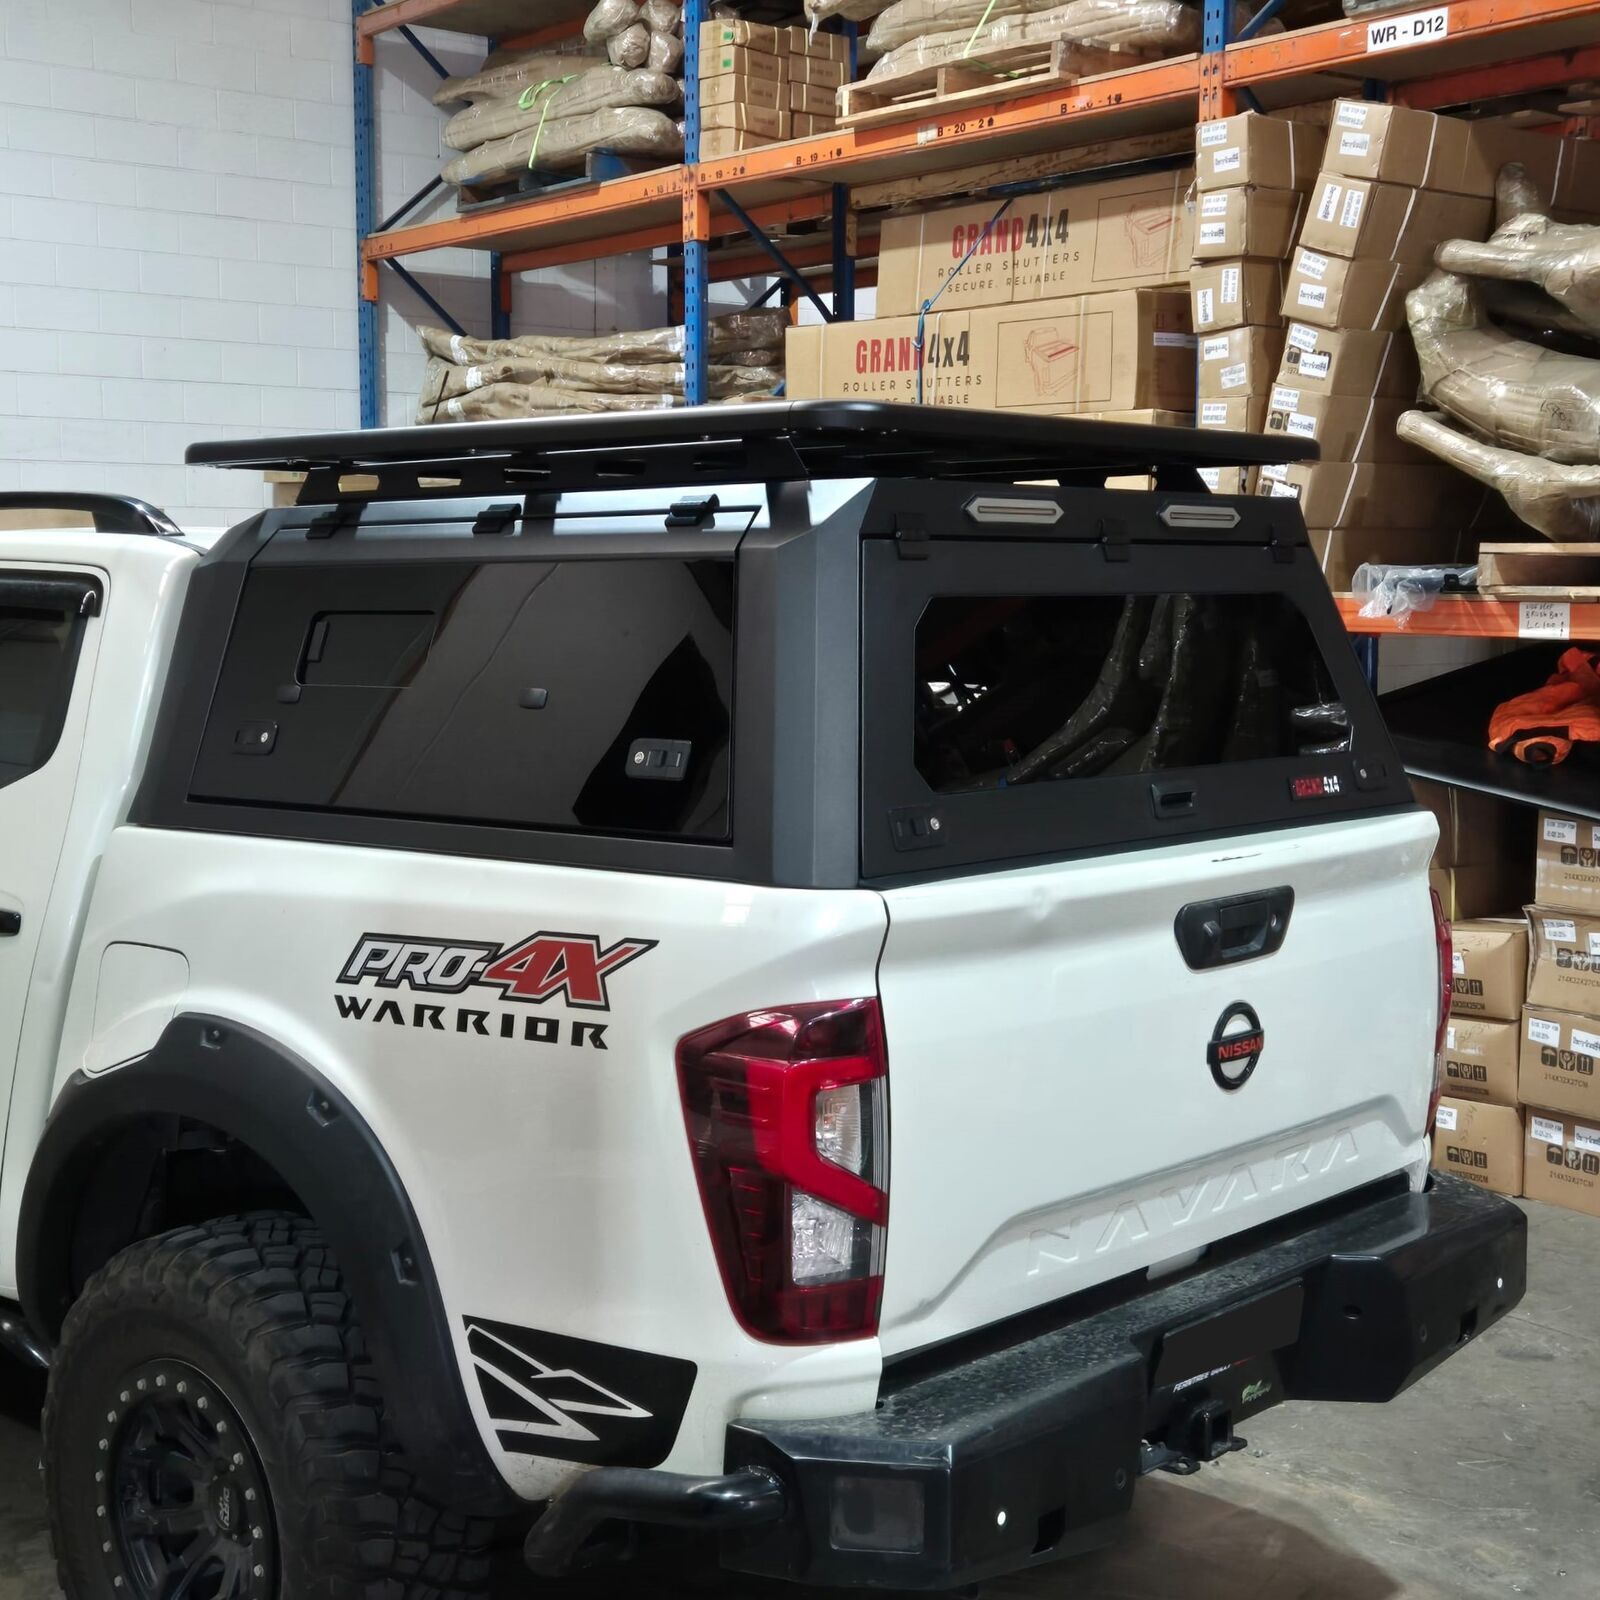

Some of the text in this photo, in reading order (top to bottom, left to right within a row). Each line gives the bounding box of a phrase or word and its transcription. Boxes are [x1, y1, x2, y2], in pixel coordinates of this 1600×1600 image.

[1371, 25, 1397, 45] WR
[1413, 15, 1444, 36] D12
[937, 251, 1081, 279] ROLLER SHUTERS
[1006, 270, 1066, 286] RELIABLE
[842, 374, 983, 393] ROLLER SUTTERS
[910, 393, 969, 405] RLIABLE
[335, 930, 661, 1012] PRO-4X
[333, 993, 609, 1050] WARRIOR
[1217, 1035, 1264, 1060] NISSAN
[1026, 1126, 1360, 1277] NAVARA
